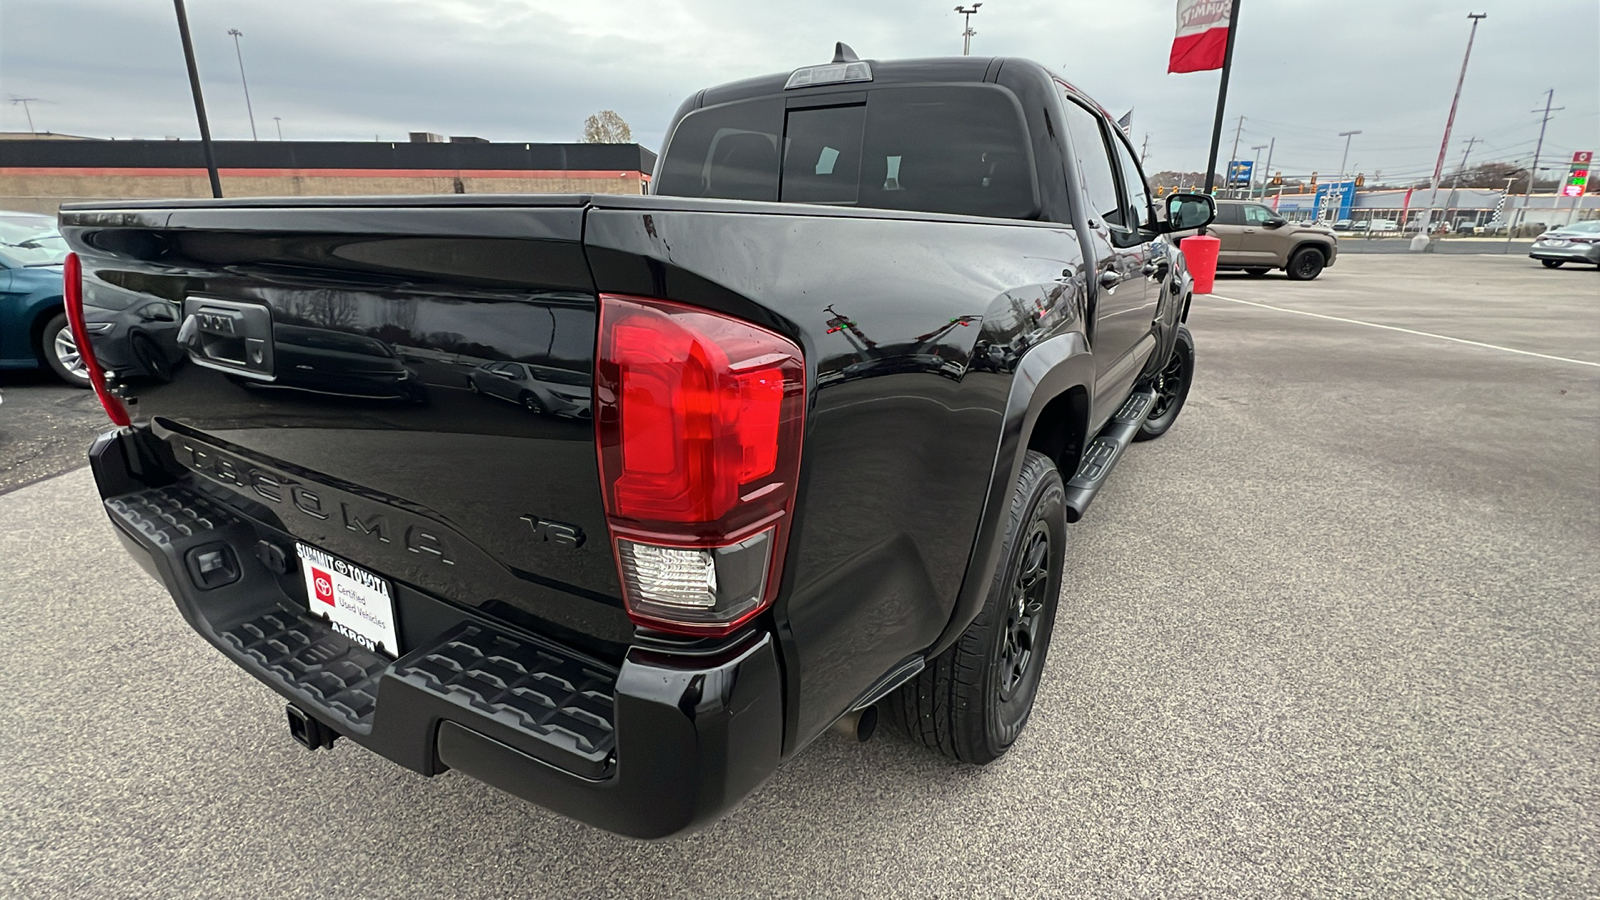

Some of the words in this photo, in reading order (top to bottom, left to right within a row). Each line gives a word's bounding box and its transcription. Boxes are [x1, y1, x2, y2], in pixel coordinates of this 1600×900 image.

[182, 441, 455, 565] TACOMA
[296, 542, 334, 570] SUMMIT
[347, 564, 388, 597] TOYOTA
[337, 583, 366, 606] Certified
[338, 597, 357, 613] Used
[357, 606, 386, 629] Vehicles
[331, 621, 376, 652] AKRON
